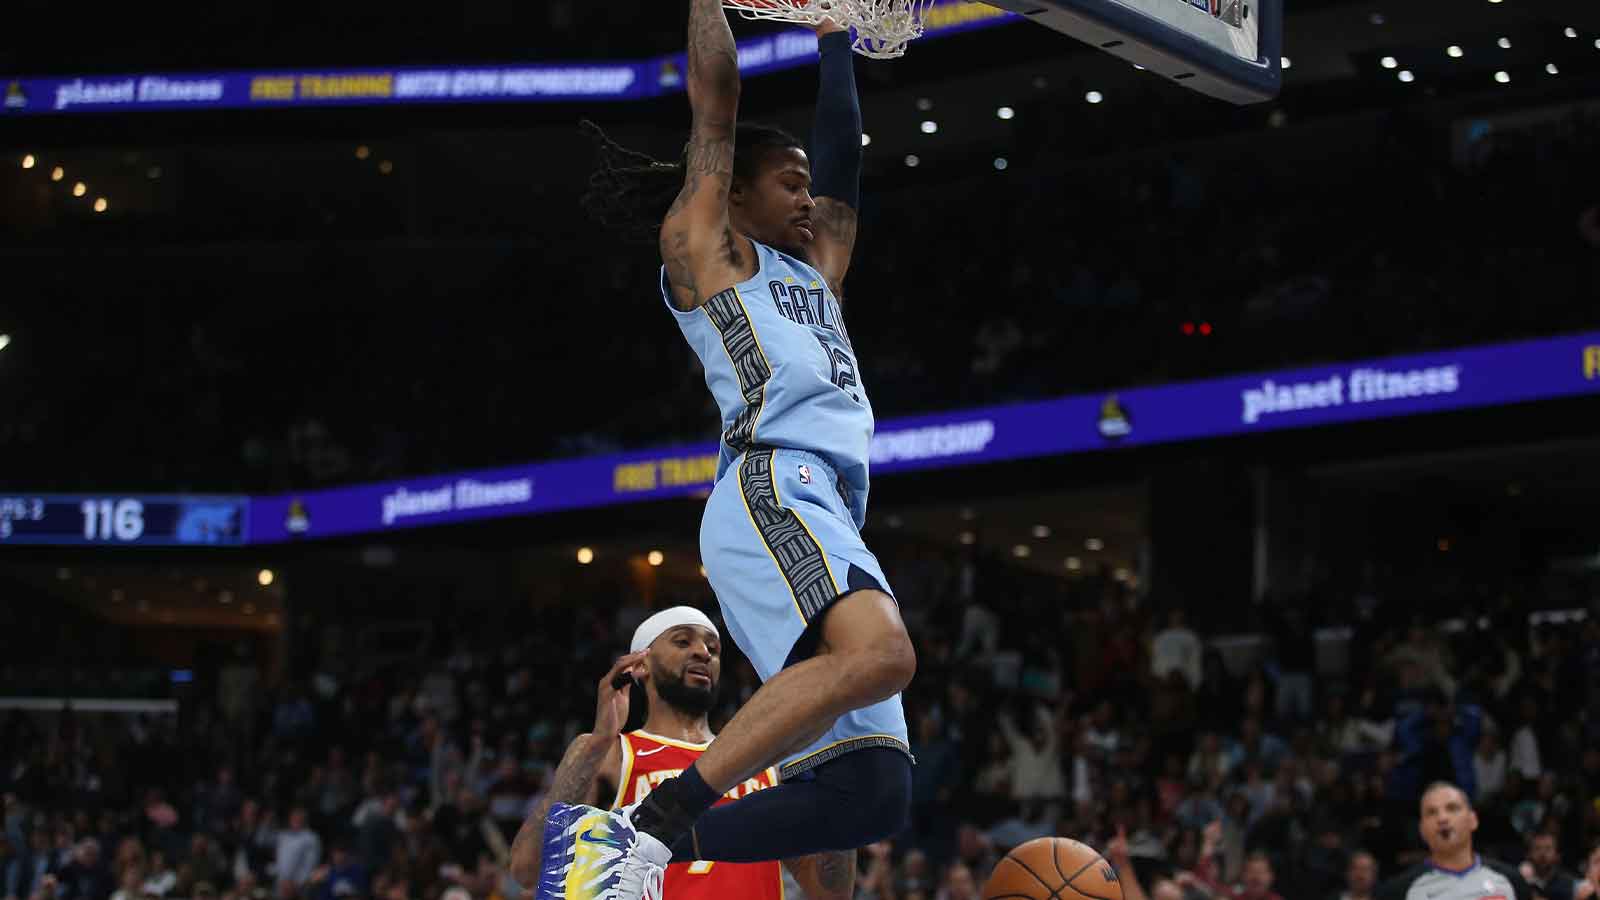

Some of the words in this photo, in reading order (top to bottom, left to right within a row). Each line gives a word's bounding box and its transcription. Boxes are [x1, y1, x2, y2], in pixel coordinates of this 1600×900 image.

[54, 78, 135, 109] planet
[138, 75, 223, 101] fitness
[251, 75, 295, 100] FREE
[300, 73, 393, 99] TRAINING
[499, 67, 635, 96] MEMBERSHIP
[1242, 376, 1343, 424] planet
[1350, 364, 1458, 402] fitness
[613, 463, 656, 493] FREE
[82, 498, 145, 540] 116
[382, 486, 452, 525] planet
[455, 478, 532, 509] fitness
